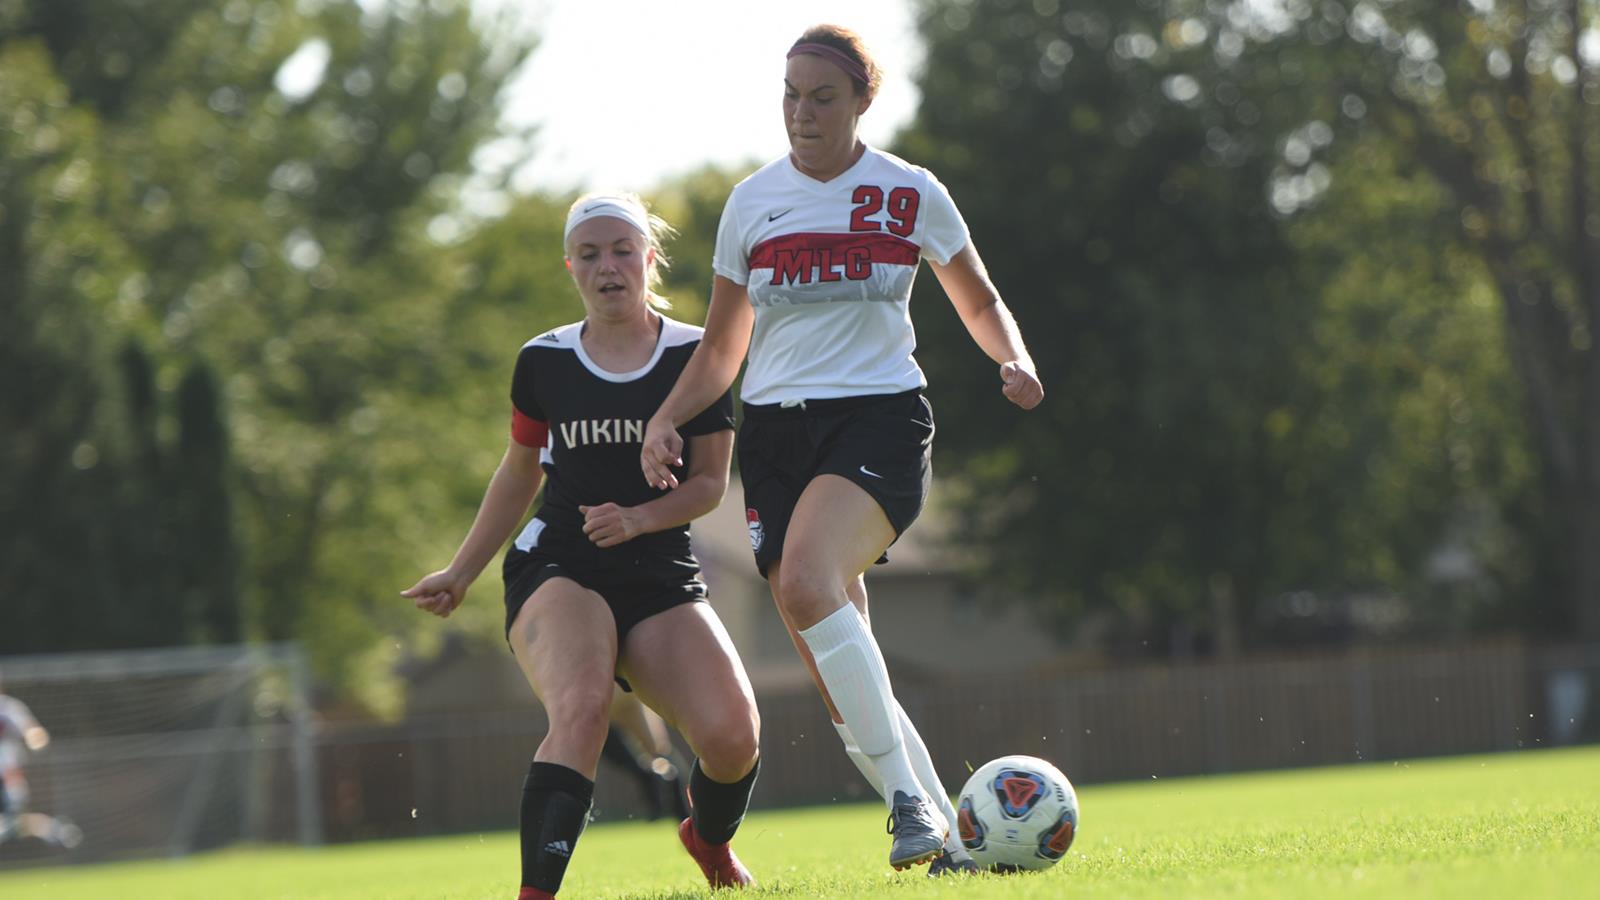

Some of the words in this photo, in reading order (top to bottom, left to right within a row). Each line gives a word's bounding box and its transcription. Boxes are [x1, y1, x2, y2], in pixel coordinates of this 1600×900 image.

[850, 185, 921, 238] 29
[769, 246, 872, 286] MLC
[560, 418, 643, 450] VIKIN
